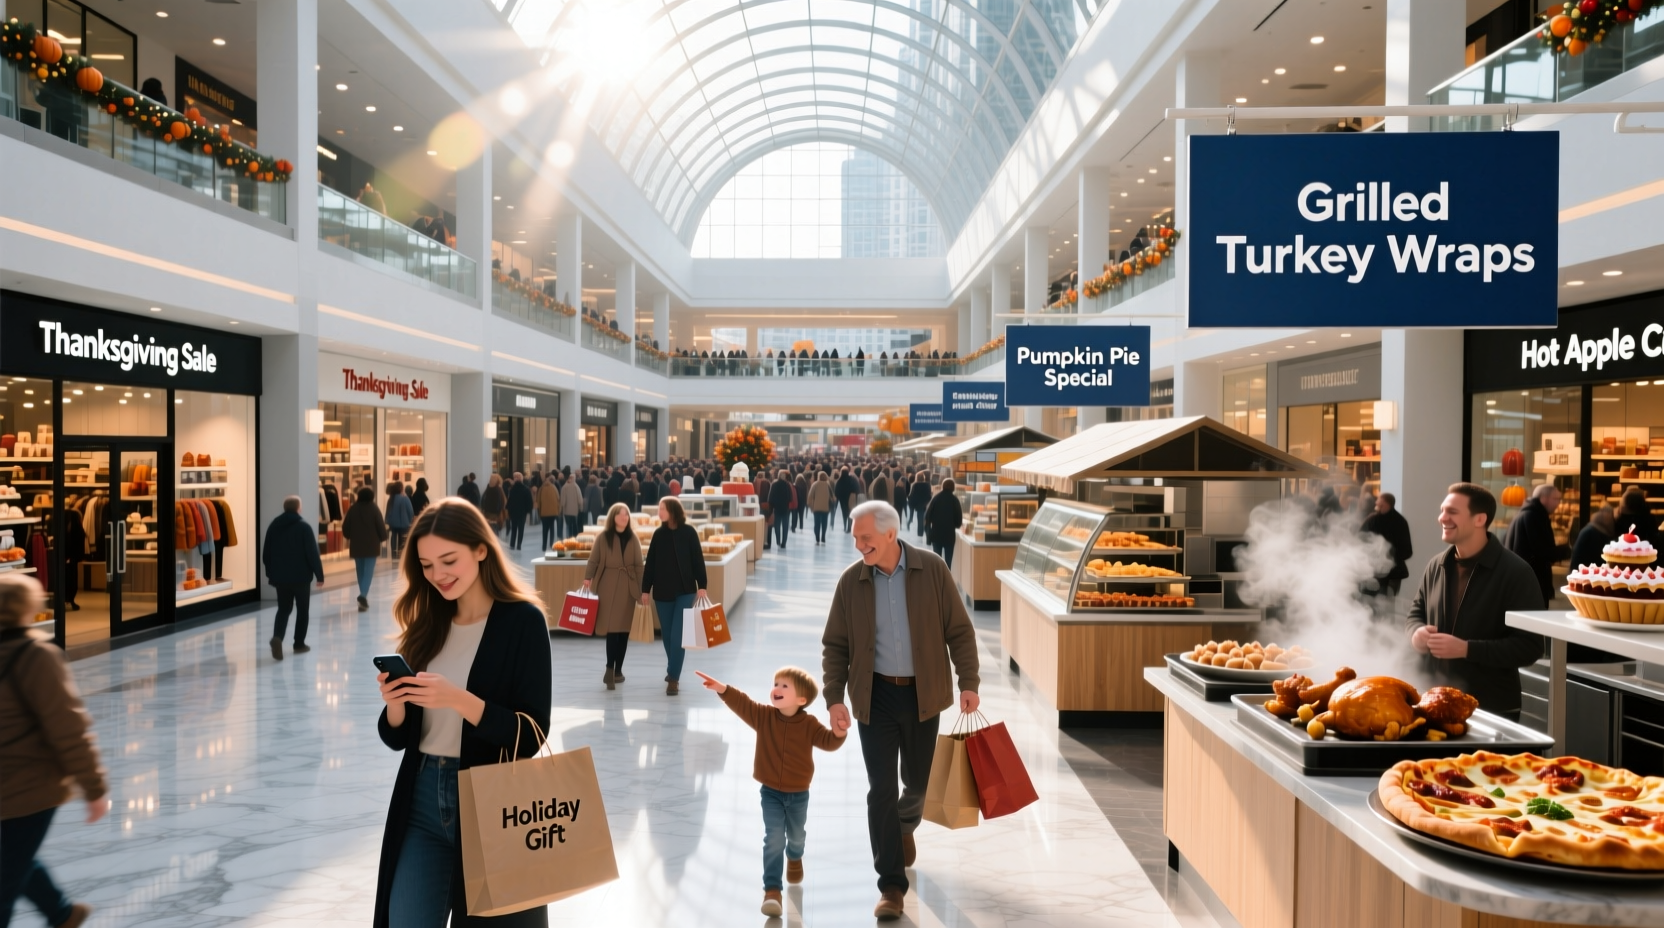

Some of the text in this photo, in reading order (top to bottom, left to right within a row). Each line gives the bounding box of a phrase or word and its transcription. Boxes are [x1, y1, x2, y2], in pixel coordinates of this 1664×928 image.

[1297, 181, 1449, 222] Grilled
[1216, 234, 1535, 283] Turkey Wraps
[39, 320, 217, 376] Thanksgiving Sale
[1017, 346, 1140, 369] Pumpkin Pie
[1521, 338, 1560, 369] Hot
[1563, 327, 1635, 371] Apple
[1044, 368, 1112, 390] Special
[502, 798, 580, 829] Holiday
[525, 823, 566, 851] Gift
